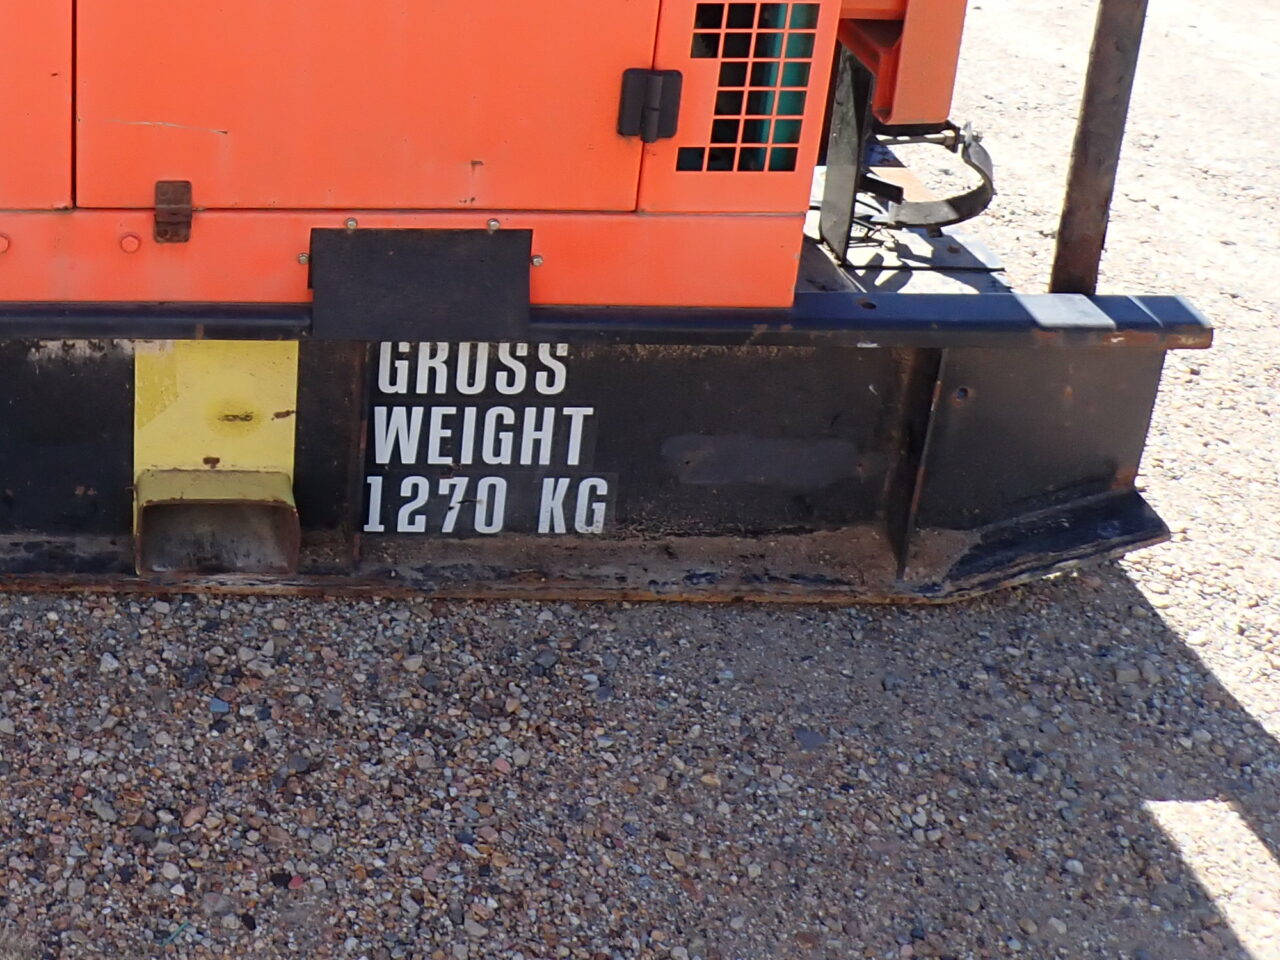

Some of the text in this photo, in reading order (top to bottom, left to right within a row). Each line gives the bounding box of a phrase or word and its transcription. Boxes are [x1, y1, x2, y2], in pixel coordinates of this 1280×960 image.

[377, 341, 569, 395] GROSS
[374, 406, 594, 466] WEIGHT
[363, 475, 608, 534] 1270 KG
